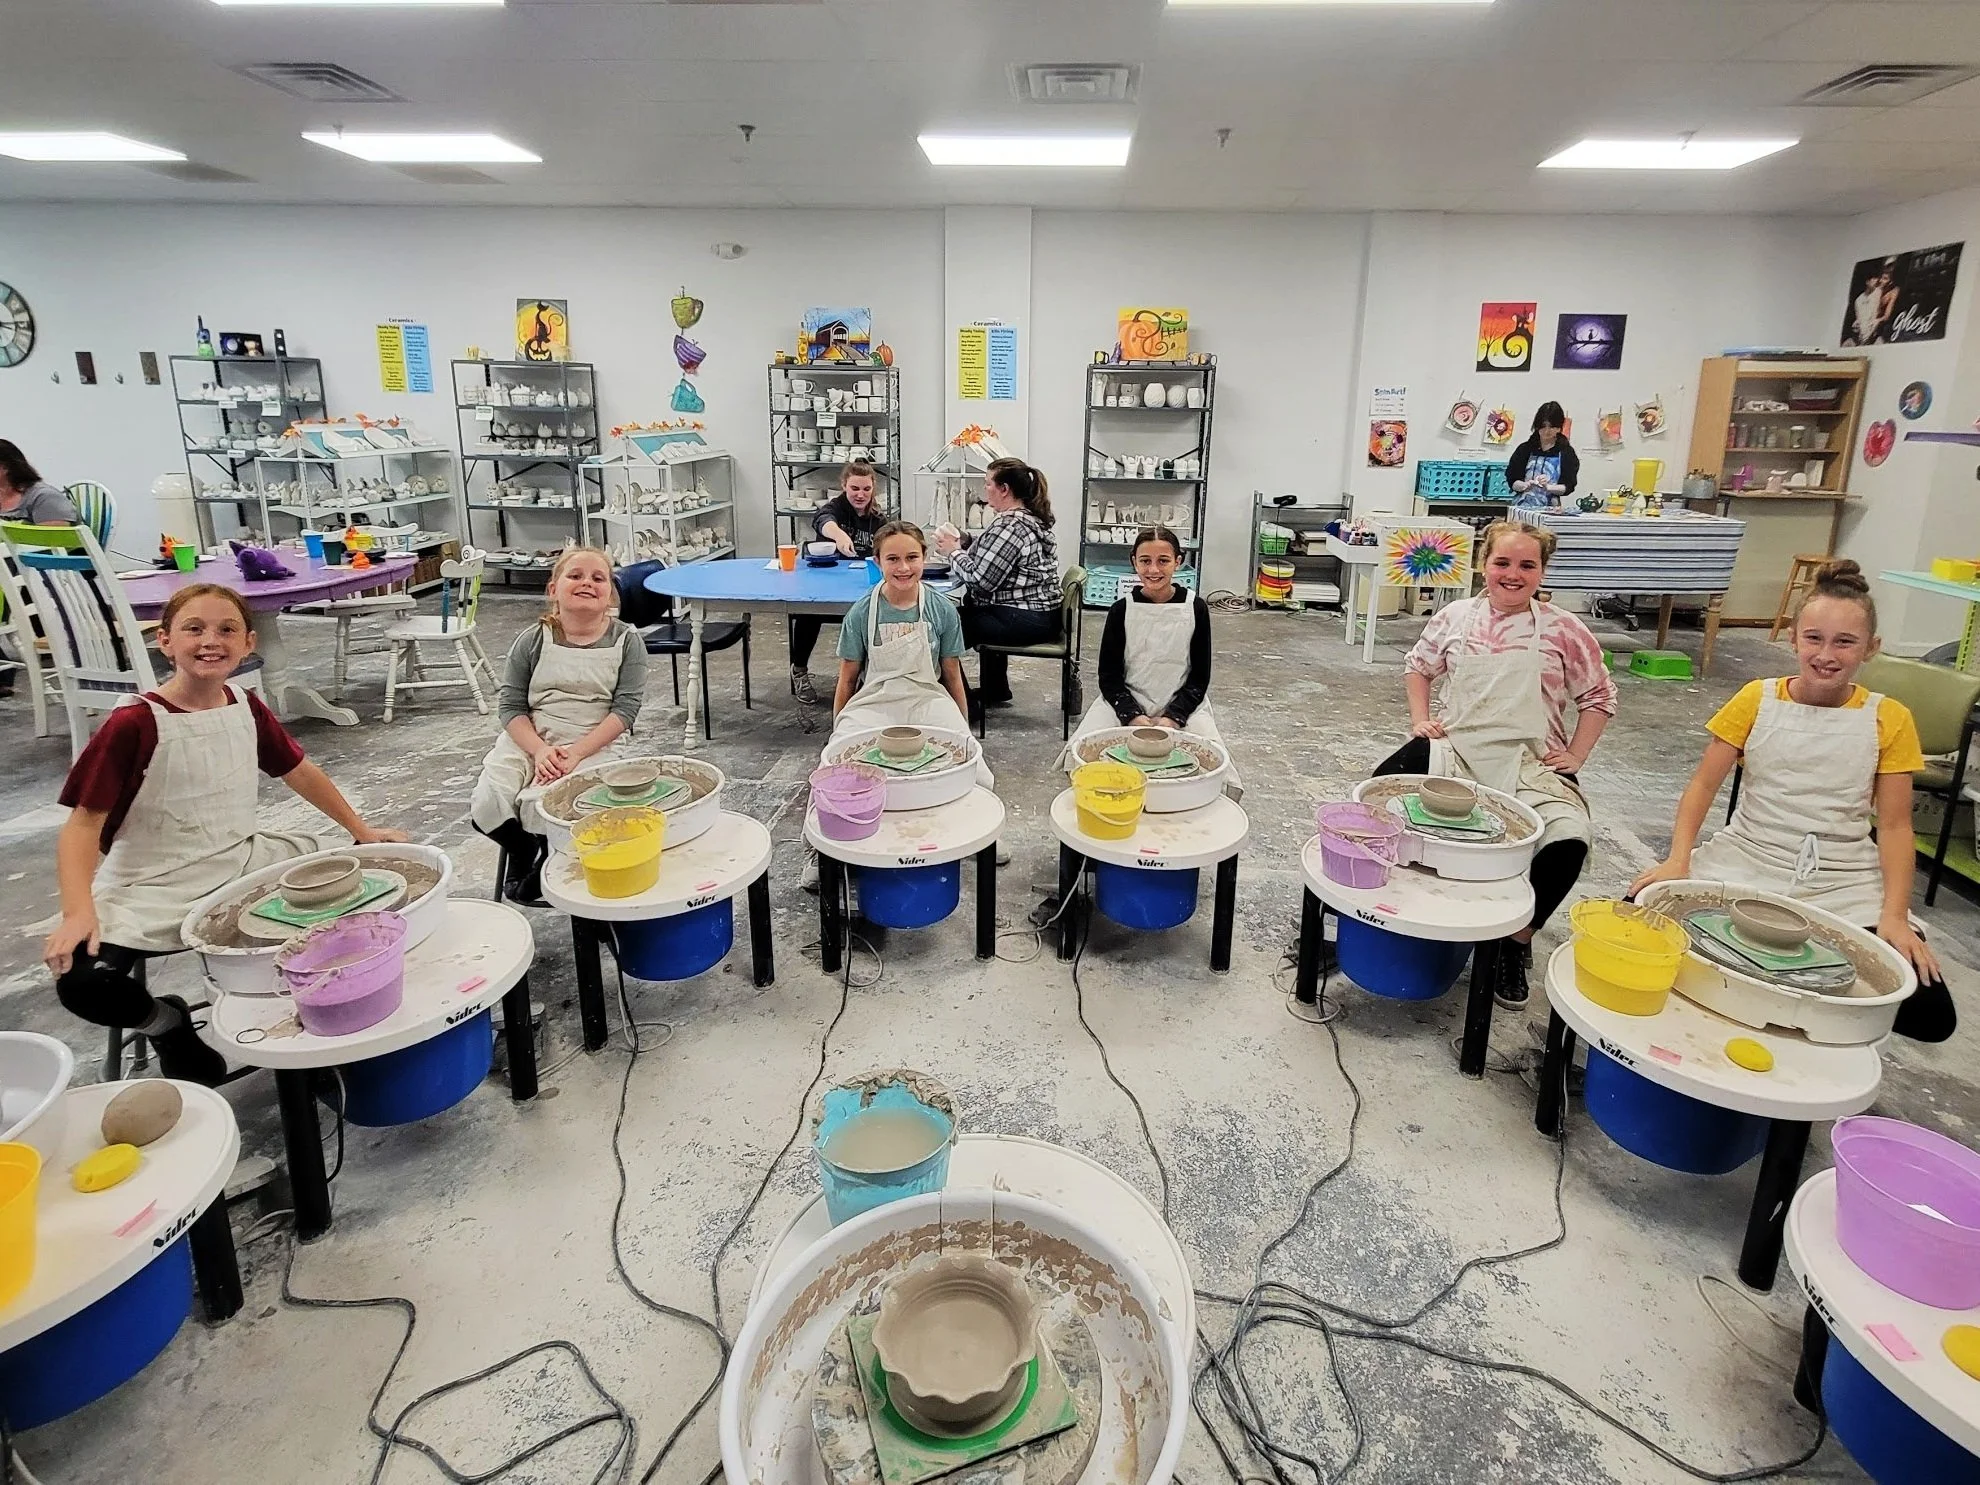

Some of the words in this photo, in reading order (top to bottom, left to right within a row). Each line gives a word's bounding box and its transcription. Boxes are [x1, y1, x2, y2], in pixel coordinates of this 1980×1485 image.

[895, 856, 927, 865] Nidec
[1136, 858, 1168, 867] Nidec
[685, 894, 719, 908] Nidec
[1353, 908, 1389, 926] Nidec
[443, 999, 484, 1027] Nidec
[1596, 1037, 1639, 1068] Nidec
[152, 1203, 201, 1249] Nidec
[1801, 1273, 1840, 1330] Nidec
